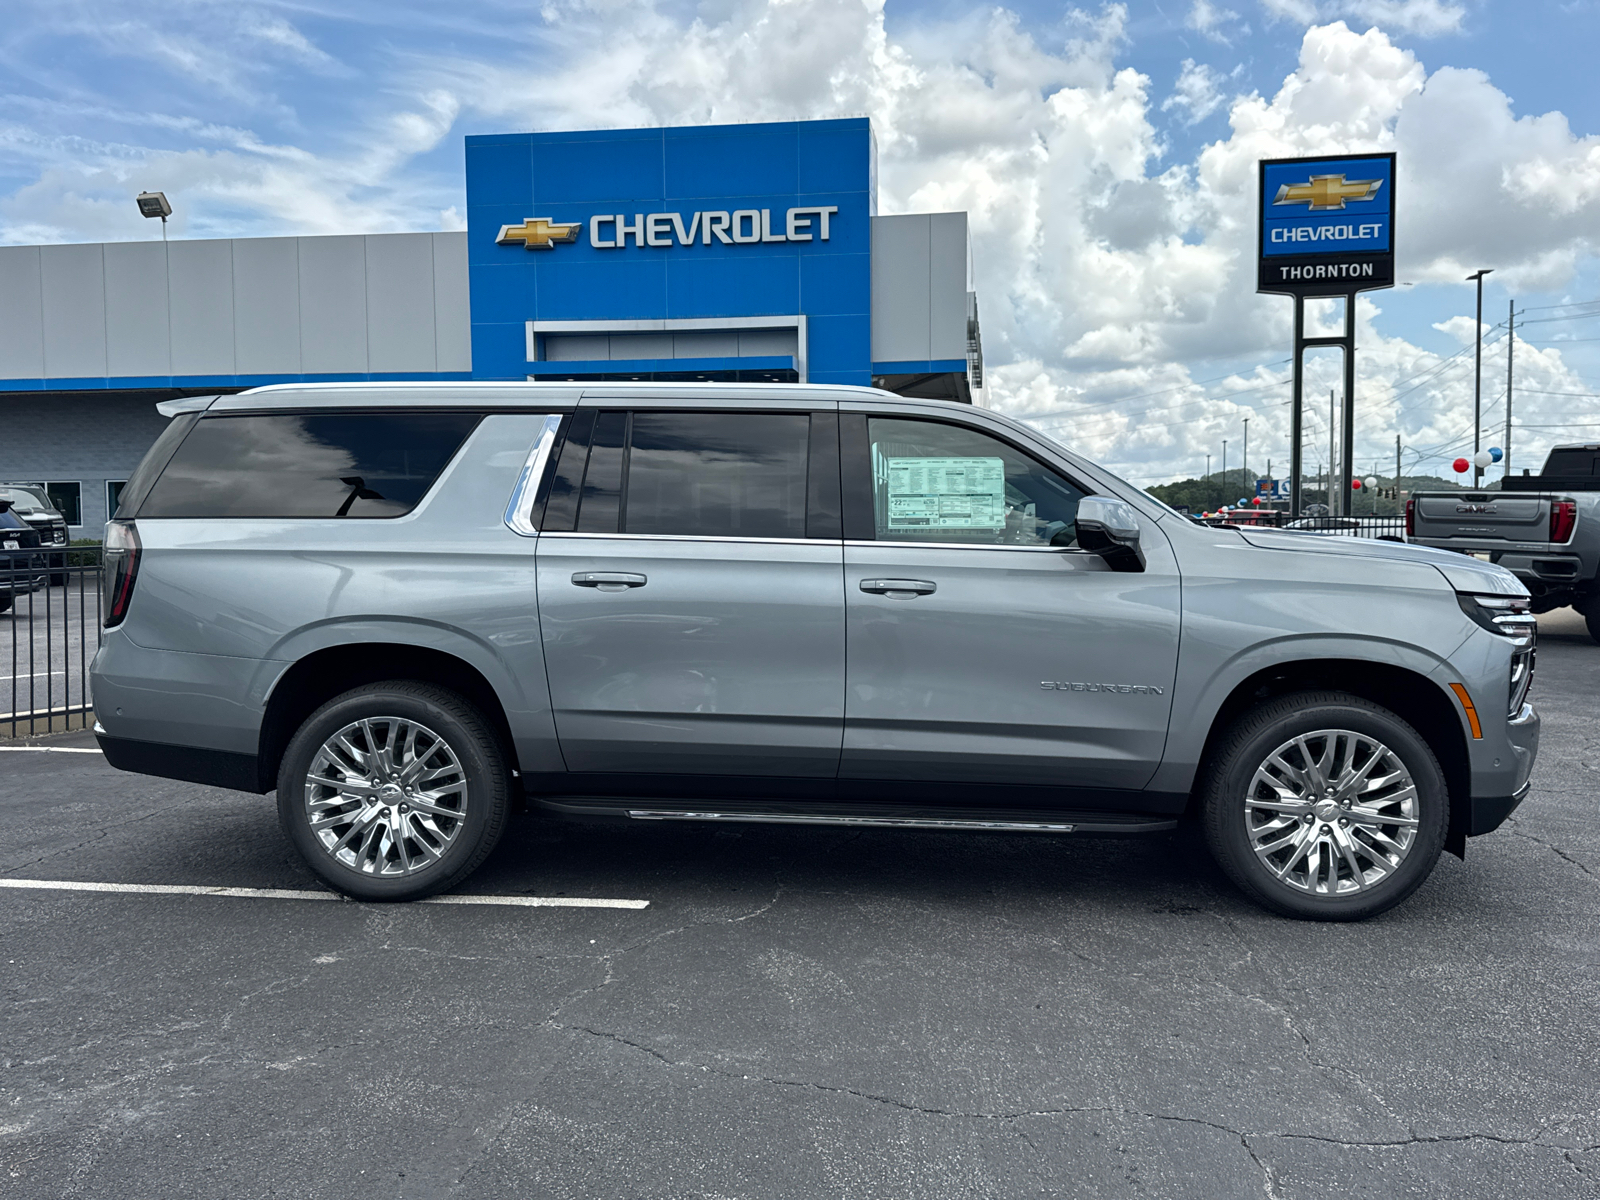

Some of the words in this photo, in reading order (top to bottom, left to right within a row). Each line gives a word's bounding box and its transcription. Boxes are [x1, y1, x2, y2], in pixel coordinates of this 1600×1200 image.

[590, 206, 838, 248] CHEVROLET
[1271, 223, 1383, 243] CHEVROLET
[1280, 263, 1373, 280] THORNTON
[1456, 504, 1498, 515] GMC
[1040, 681, 1164, 695] SUBURBAN
